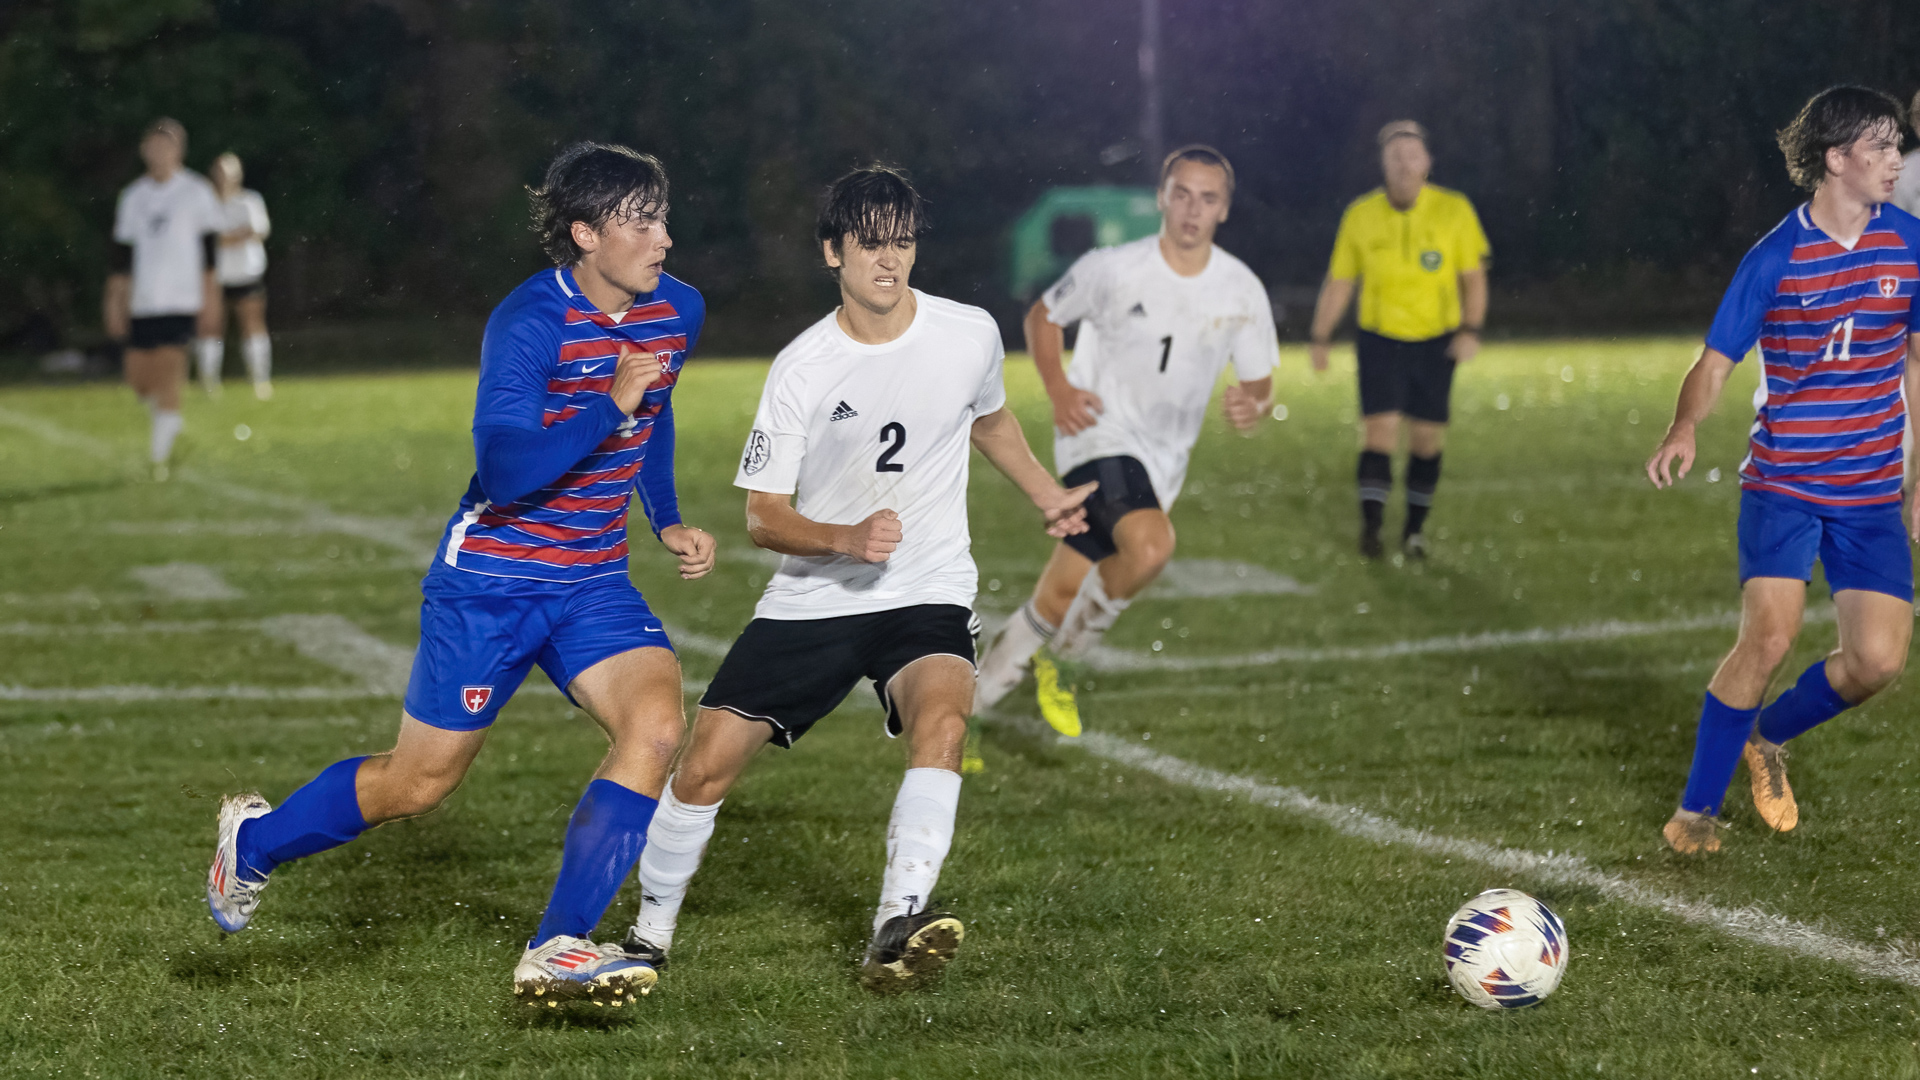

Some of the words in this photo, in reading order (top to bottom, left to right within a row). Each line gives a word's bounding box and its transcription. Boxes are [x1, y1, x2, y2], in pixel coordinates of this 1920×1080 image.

[1158, 335, 1173, 373] 1
[1822, 317, 1854, 361] 11
[830, 410, 858, 422] adidas
[876, 421, 907, 473] 2
